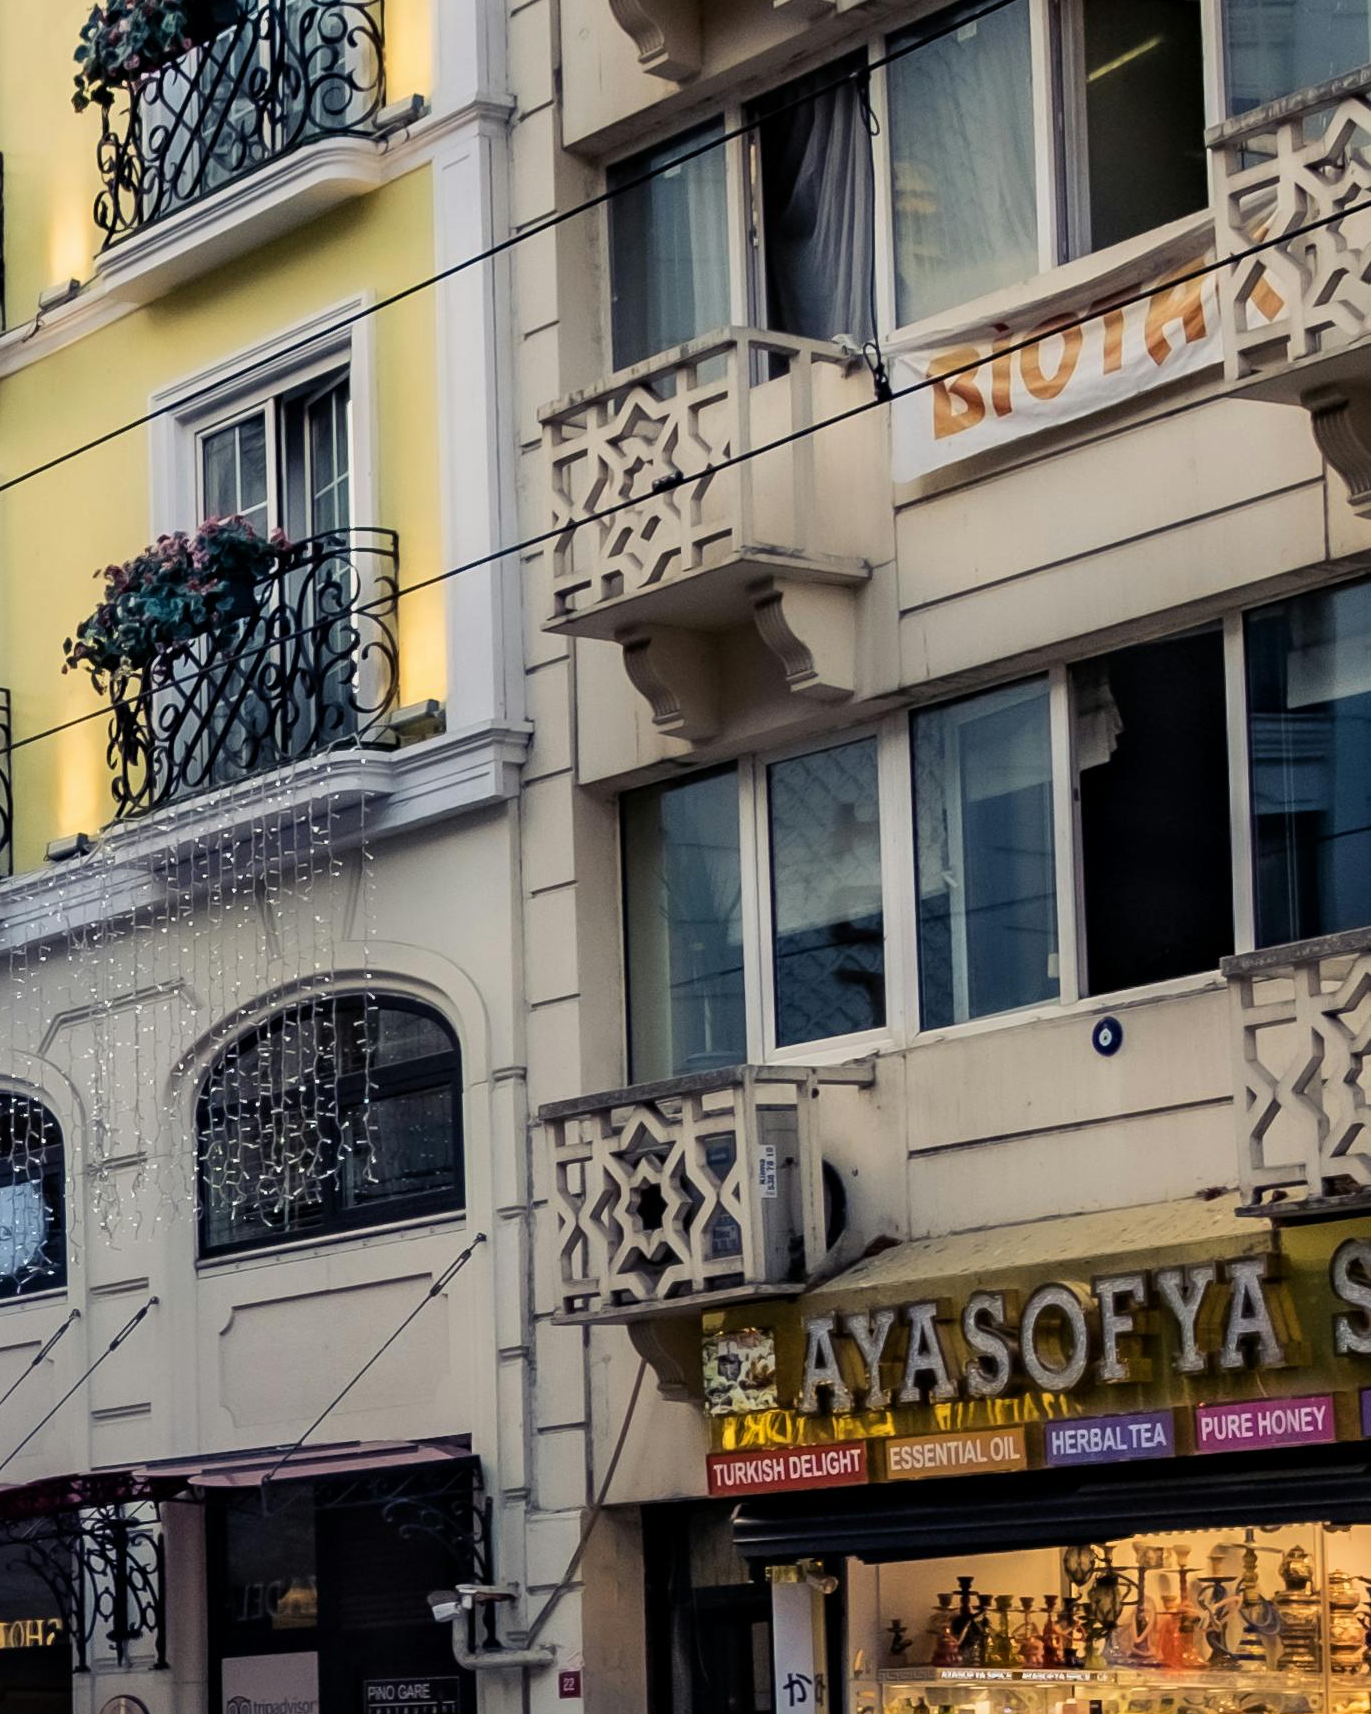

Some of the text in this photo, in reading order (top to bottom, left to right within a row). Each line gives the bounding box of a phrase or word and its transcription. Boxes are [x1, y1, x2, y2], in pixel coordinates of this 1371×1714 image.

[798, 1260, 1286, 1412] AYASOFYA
[1051, 1422, 1167, 1455] HERBAL TEA
[1201, 1405, 1326, 1441] PURE HONEY
[713, 1449, 861, 1486] TURKISH DELIGHT
[890, 1436, 1021, 1471] ESSENTIAL OIL
[398, 1683, 431, 1700] GARE
[563, 1678, 575, 1691] 22
